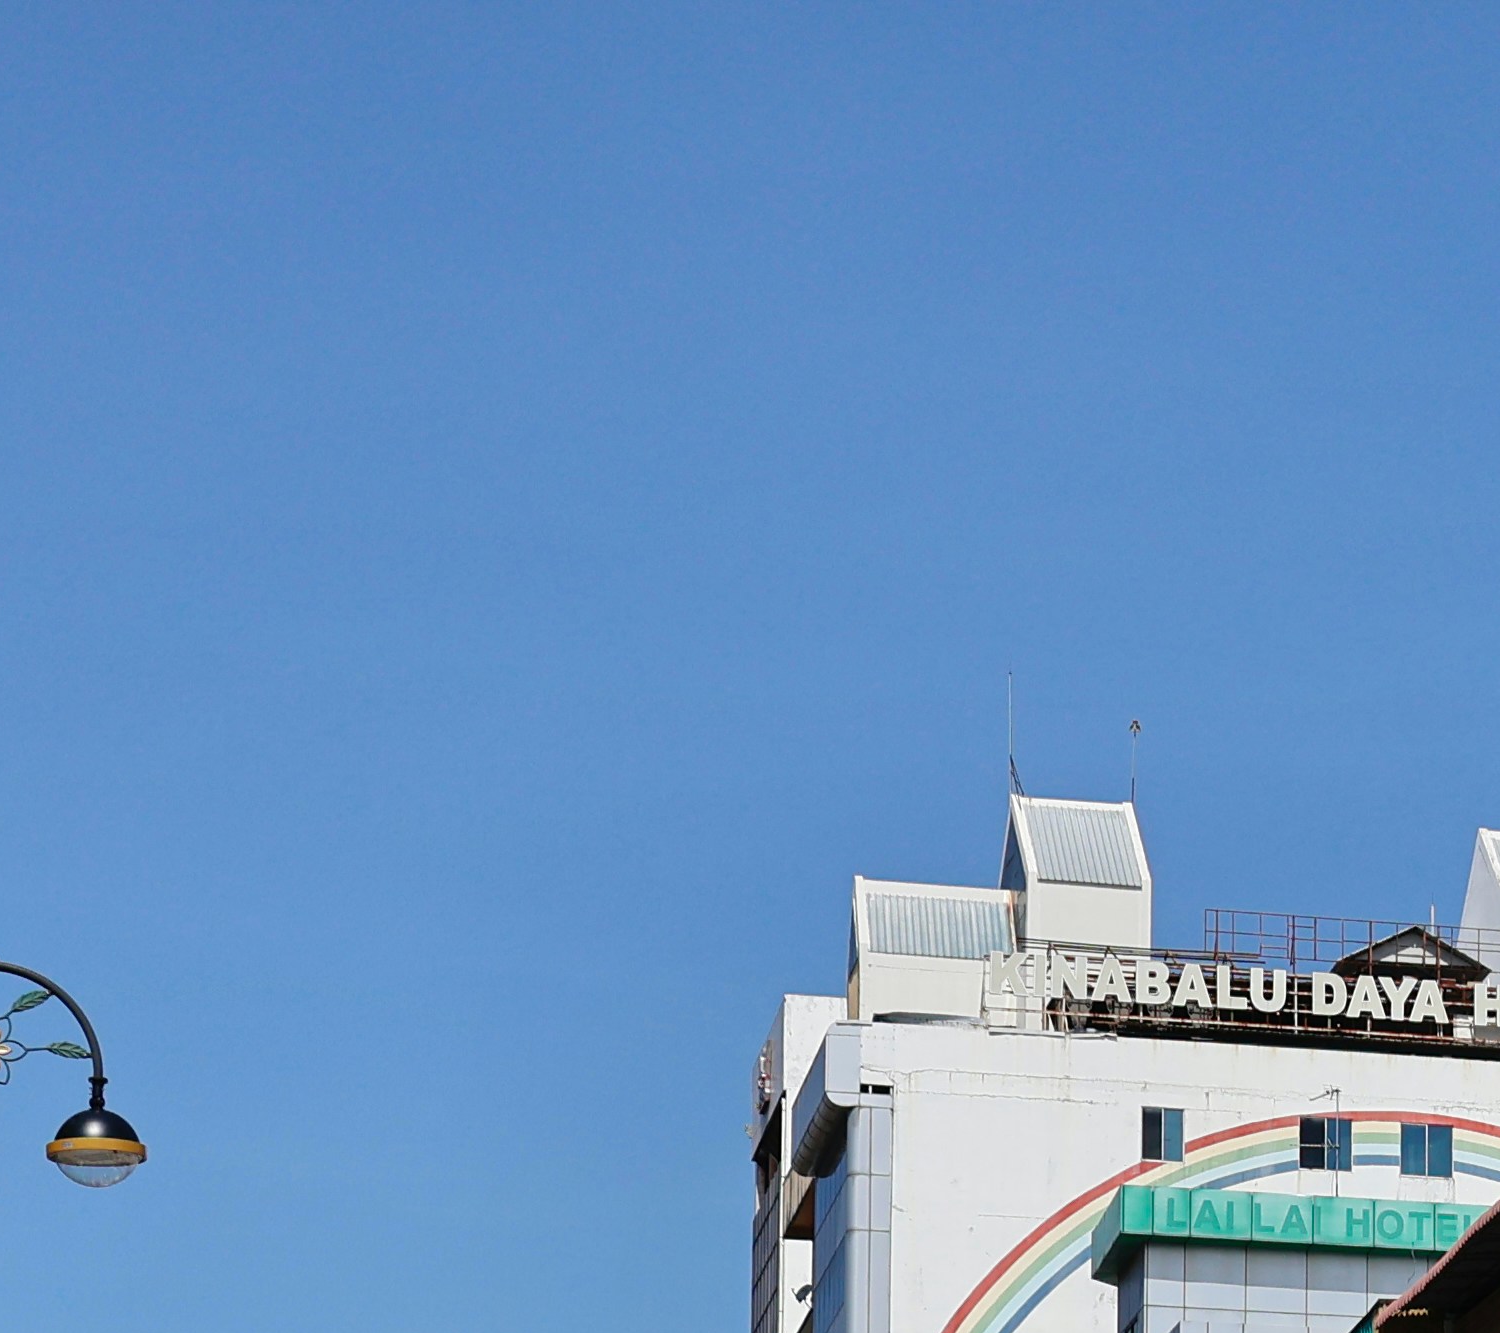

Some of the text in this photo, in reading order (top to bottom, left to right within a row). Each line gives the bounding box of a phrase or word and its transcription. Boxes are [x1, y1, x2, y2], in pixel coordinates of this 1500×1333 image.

[989, 951, 1288, 1012] KINABALU
[1311, 972, 1449, 1024] DAYA
[1166, 1197, 1234, 1231] LAI
[1254, 1203, 1321, 1236] LAI
